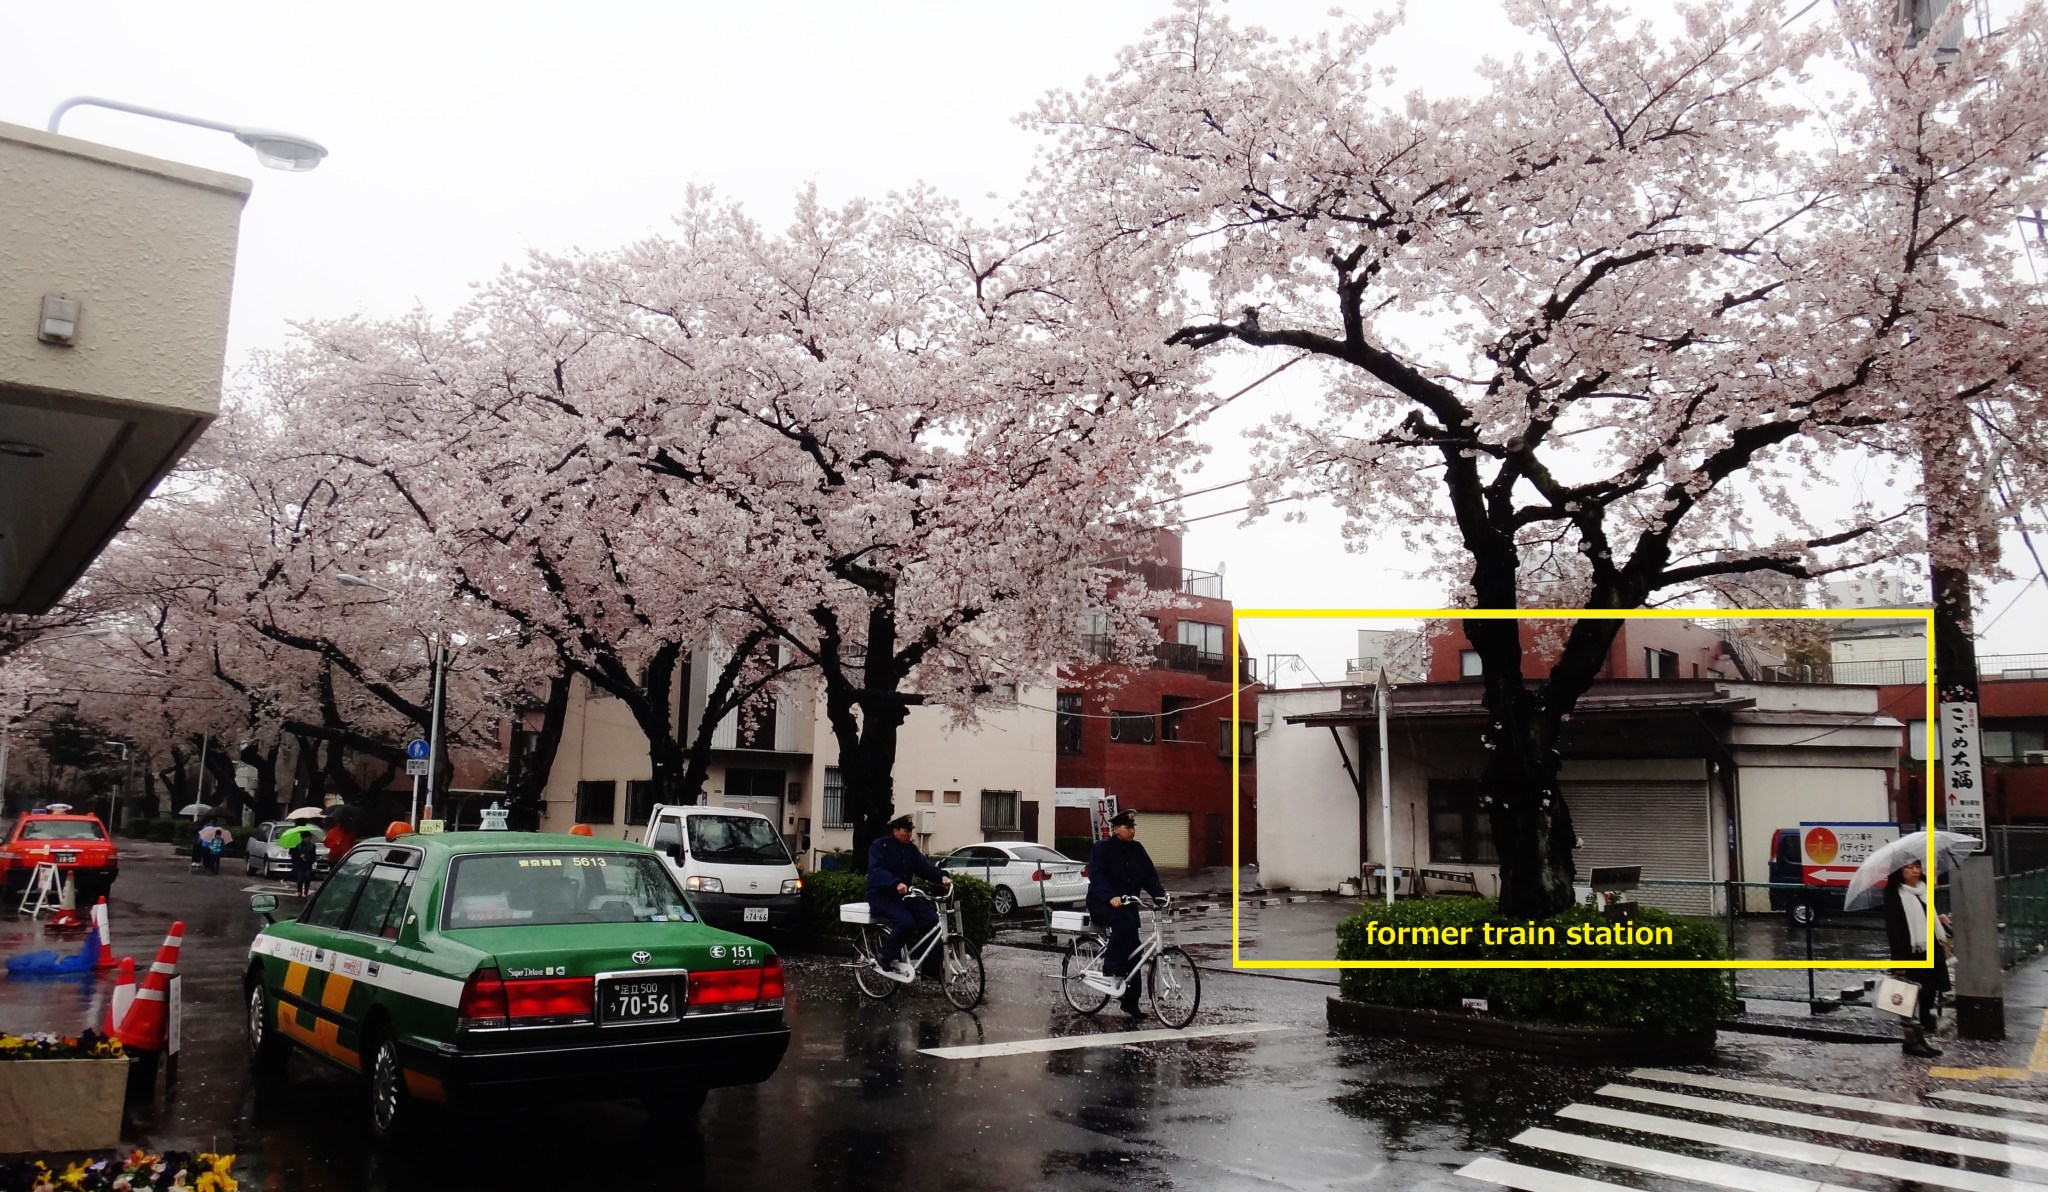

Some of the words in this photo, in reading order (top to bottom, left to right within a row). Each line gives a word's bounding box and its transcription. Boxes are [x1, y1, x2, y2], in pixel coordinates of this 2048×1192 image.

[573, 857, 607, 867] 5613
[1840, 854, 1870, 863] イナムラ
[731, 946, 753, 958] 151
[620, 994, 669, 1016] 70-56
